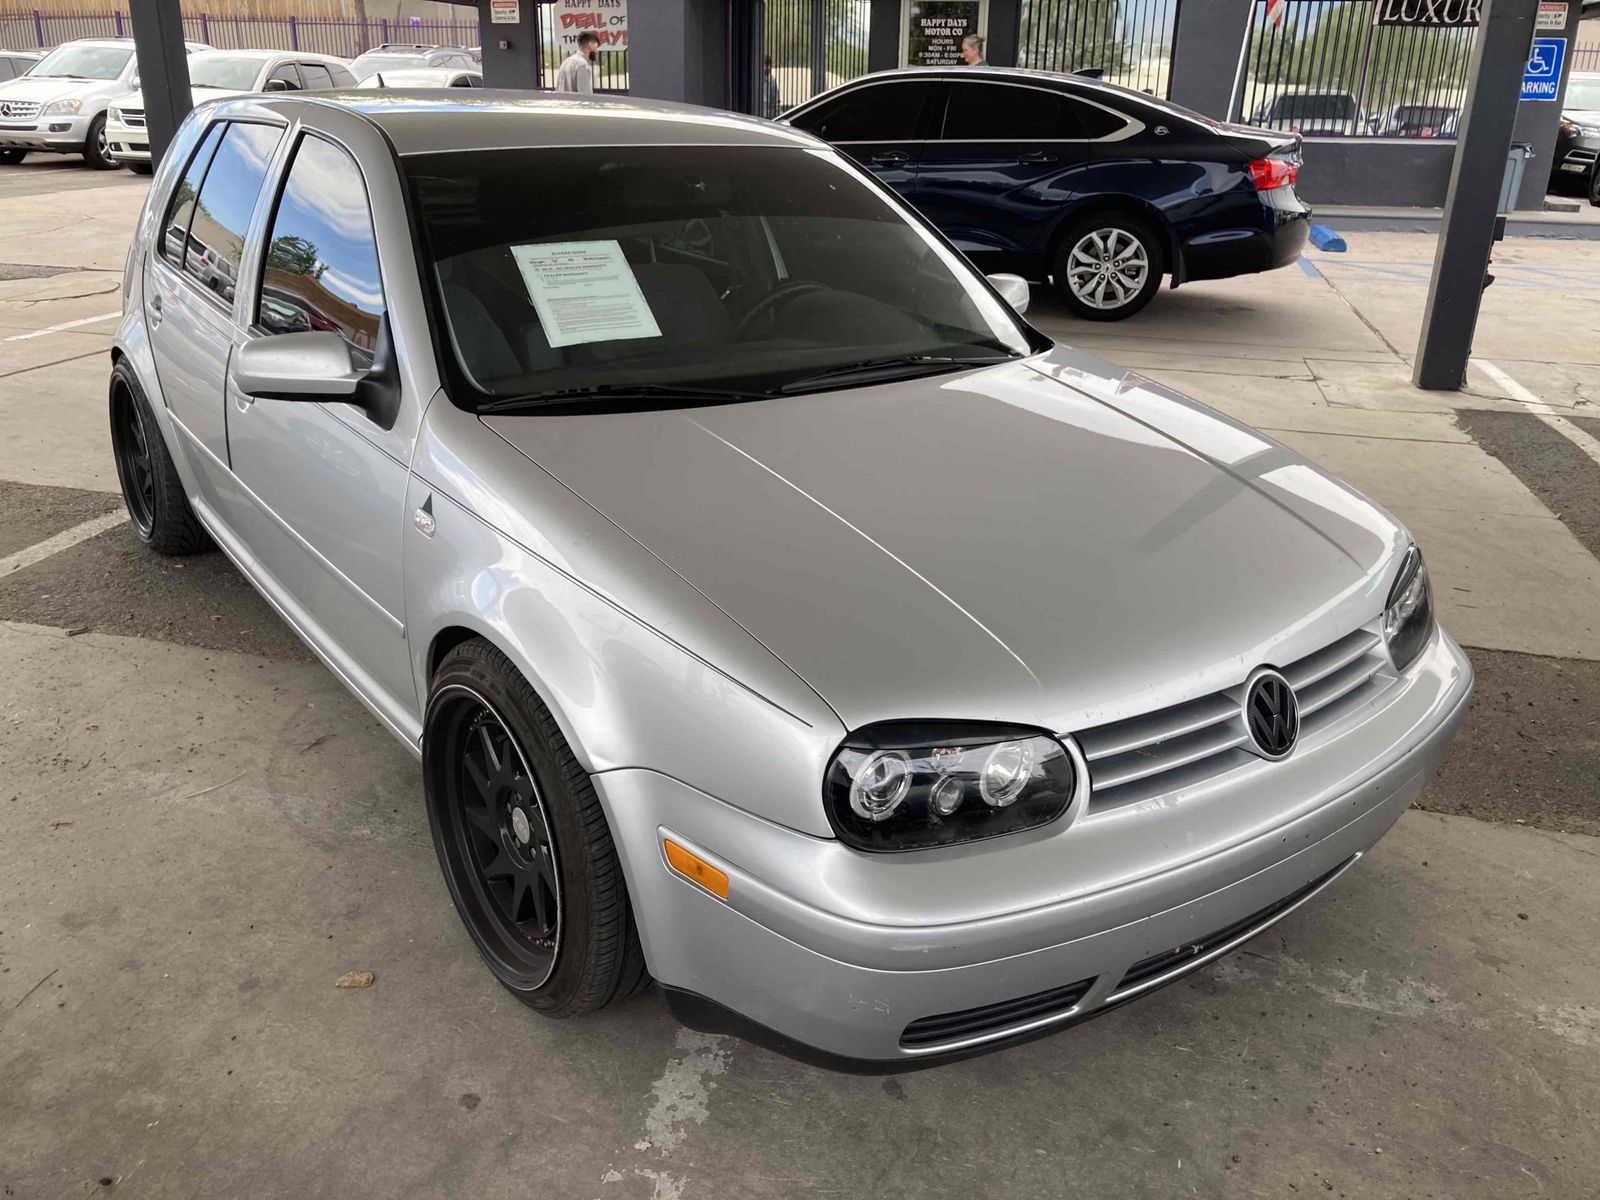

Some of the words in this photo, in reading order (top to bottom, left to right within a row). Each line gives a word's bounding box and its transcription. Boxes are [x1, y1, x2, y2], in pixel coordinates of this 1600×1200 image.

[565, 0, 591, 8] HAPPY
[598, 0, 621, 8] DAYS
[1383, 0, 1480, 23] LUXUR
[560, 13, 607, 29] DEAL
[609, 15, 626, 26] OF
[921, 18, 946, 27] HAPPY
[947, 18, 967, 27] DAYS
[563, 35, 579, 44] TH
[591, 30, 628, 46] AY!
[924, 28, 951, 36] MOTOR
[952, 28, 963, 36] CO
[1521, 81, 1556, 94] ARKING
[1251, 678, 1296, 752] VW
